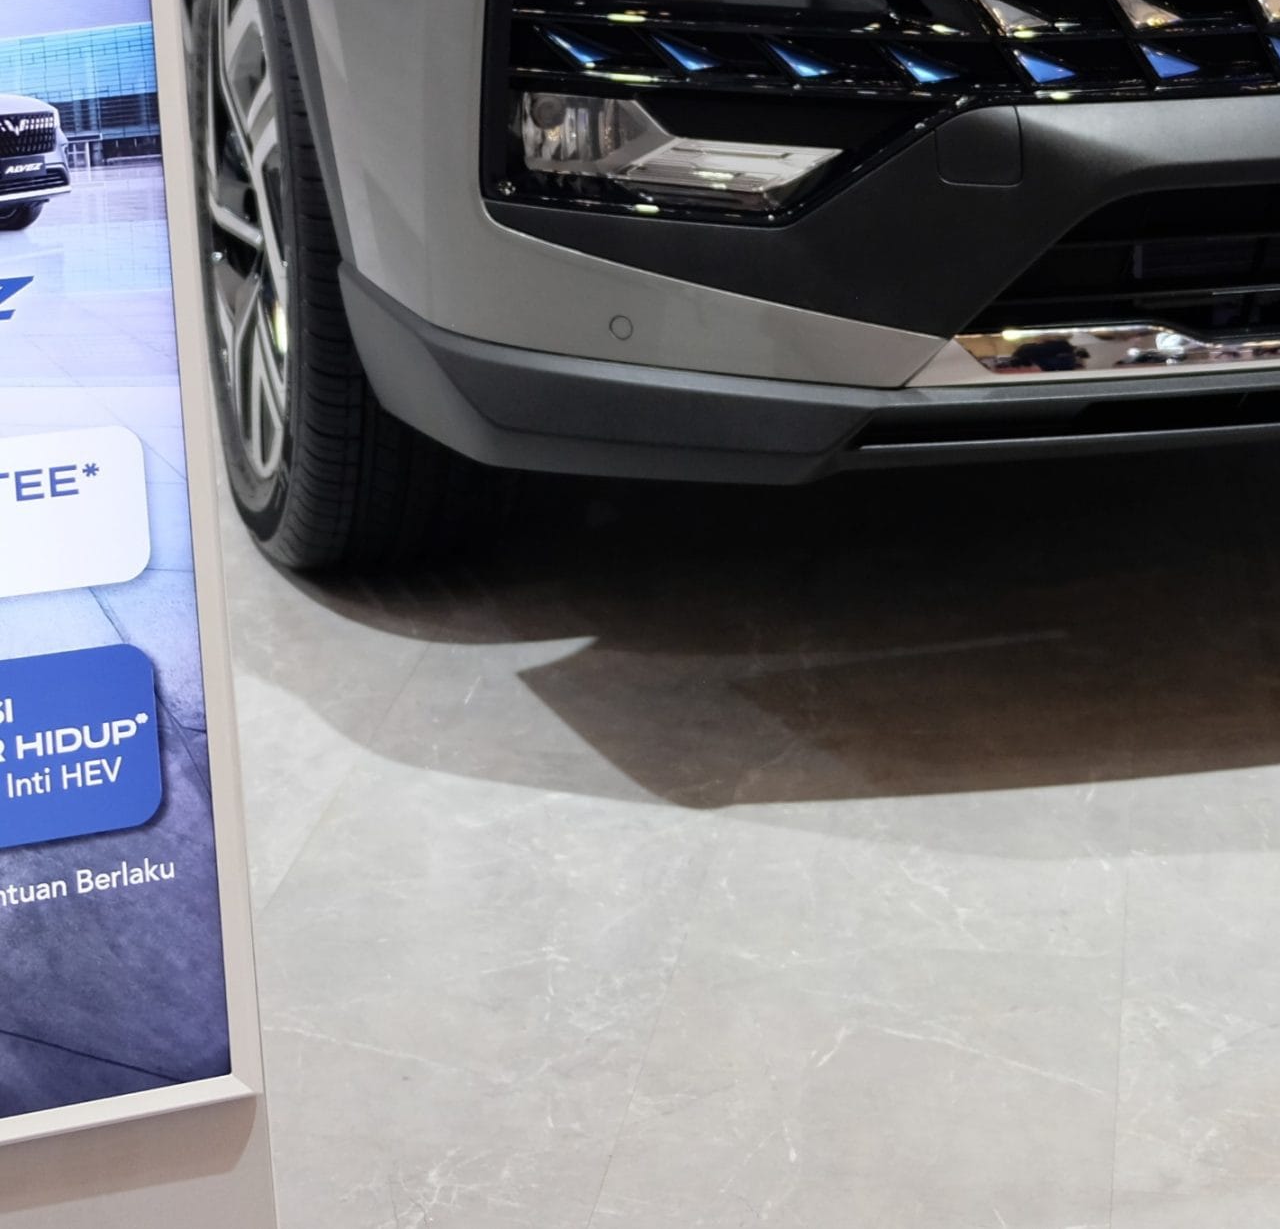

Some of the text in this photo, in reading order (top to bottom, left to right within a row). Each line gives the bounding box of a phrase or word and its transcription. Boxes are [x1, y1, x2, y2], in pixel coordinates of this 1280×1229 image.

[7, 756, 122, 798] Inti HEV
[76, 858, 175, 894] Berlaku
